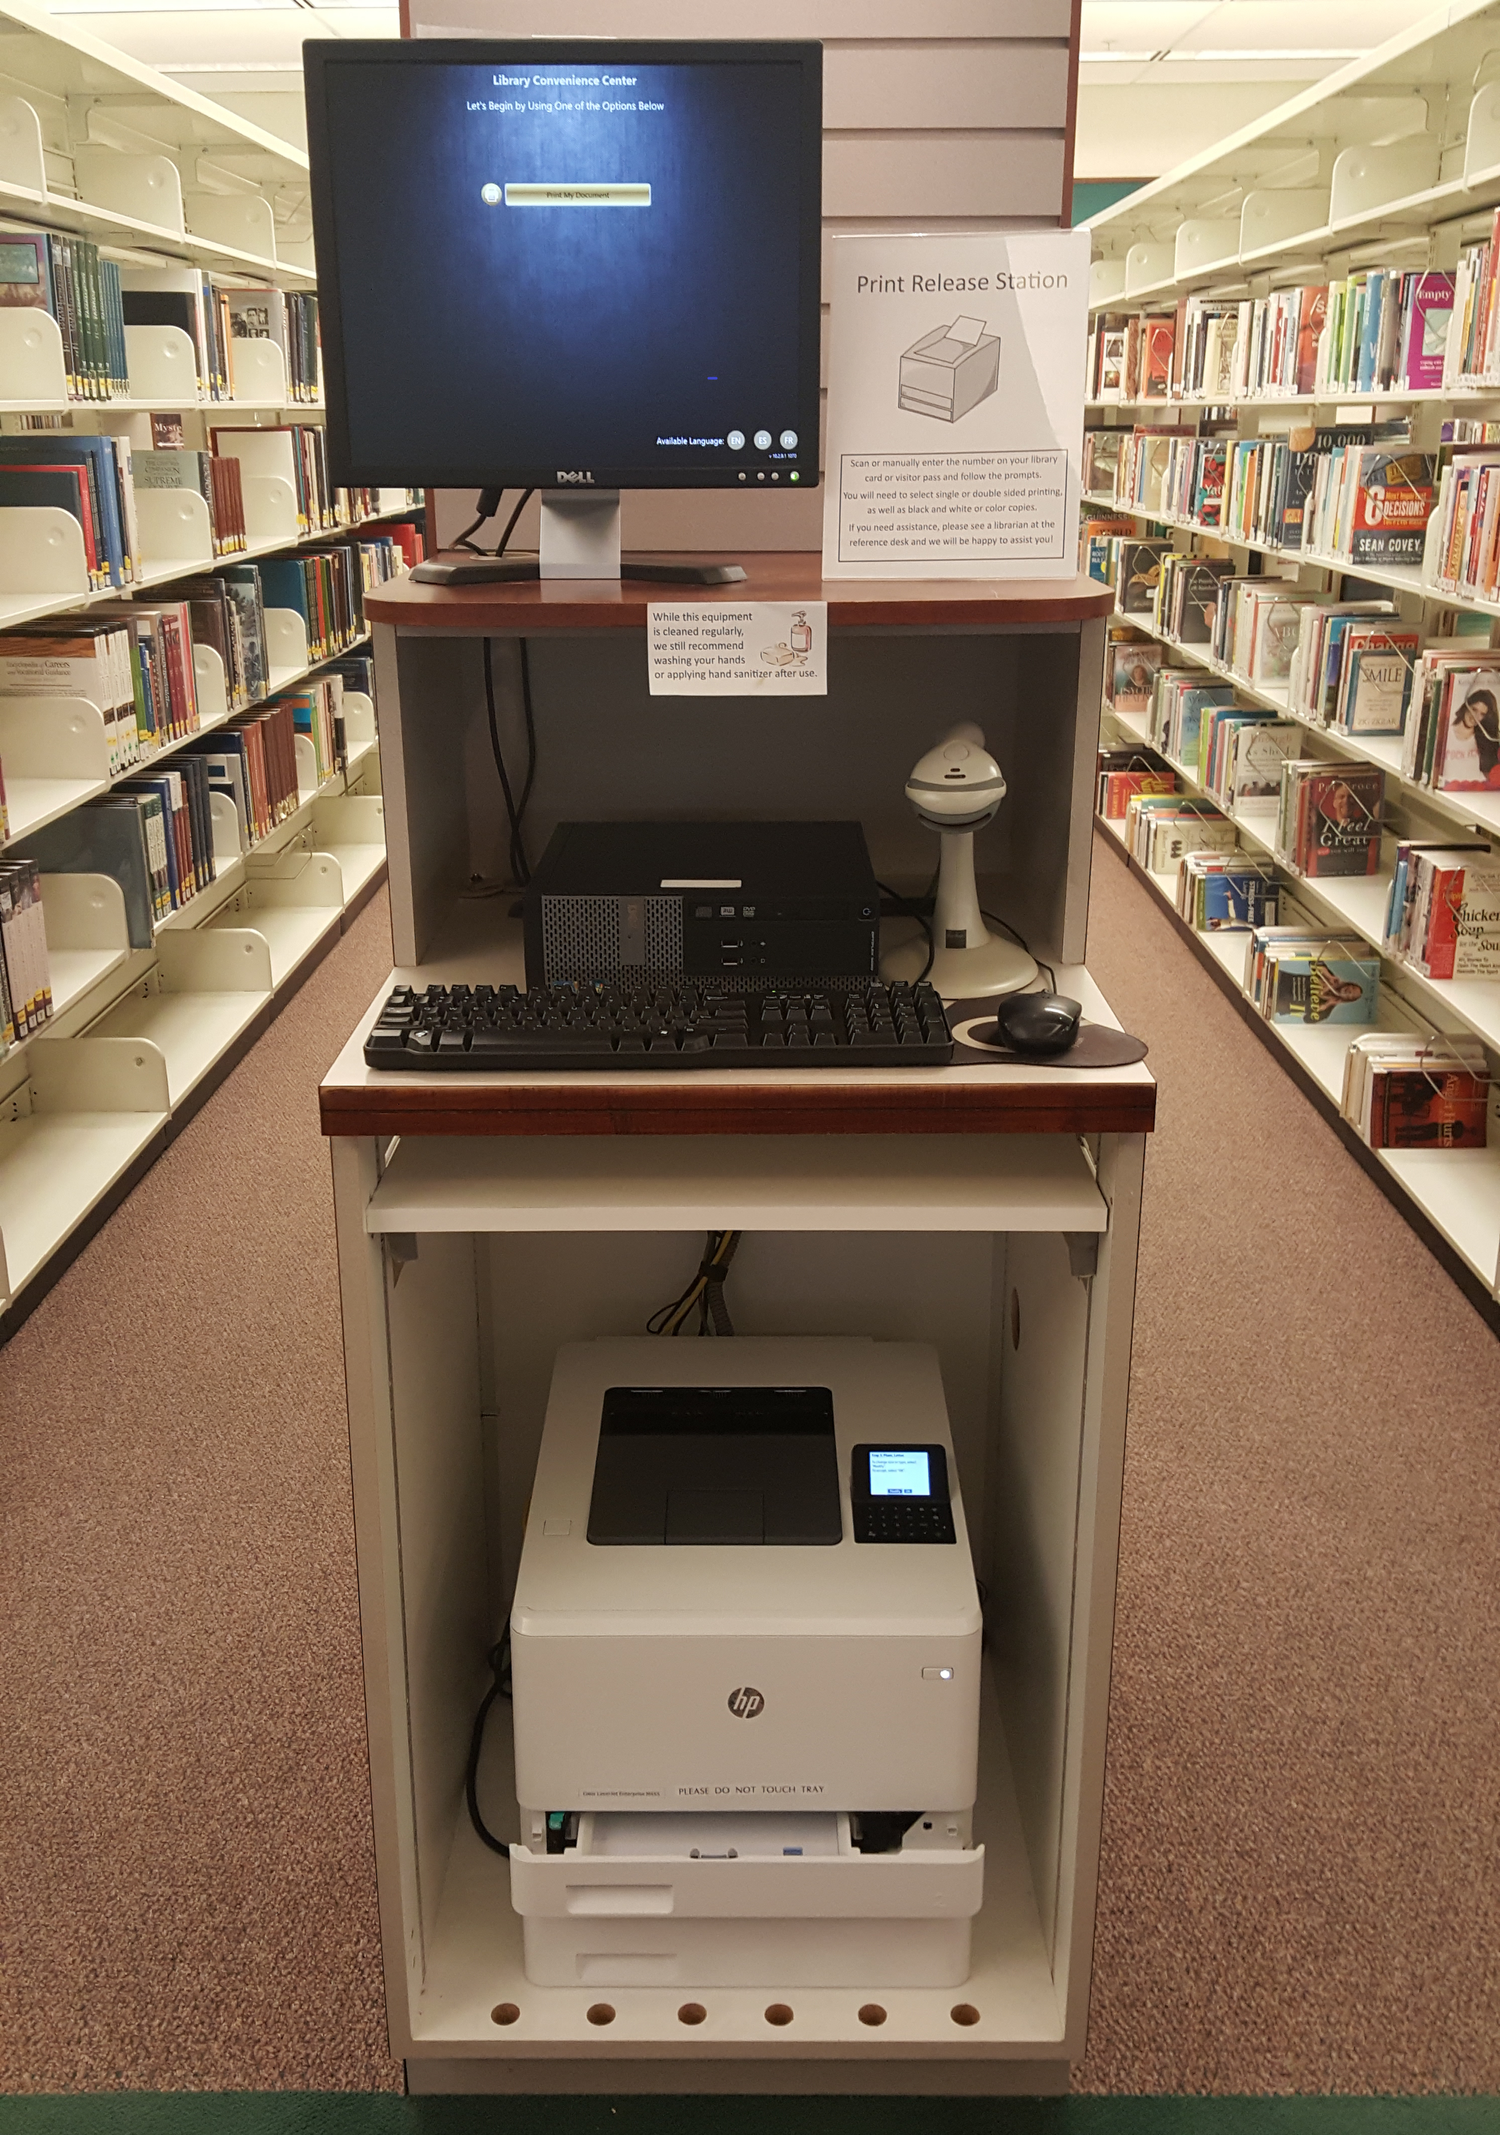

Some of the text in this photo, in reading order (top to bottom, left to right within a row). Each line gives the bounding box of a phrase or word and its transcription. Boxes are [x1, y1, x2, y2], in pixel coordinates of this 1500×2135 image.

[493, 74, 637, 88] Library Convenience Center
[467, 101, 664, 113] Let's Begin by Using One of the Options Below
[563, 192, 574, 200] My
[857, 271, 1068, 294] Print Release Station
[1418, 290, 1451, 301] Empty
[656, 437, 725, 447] Available Language:
[731, 436, 741, 445] EN
[758, 436, 767, 445] ES
[784, 436, 794, 445] FR
[850, 459, 870, 468] Scan
[883, 459, 920, 469] manually
[922, 459, 944, 467] enter
[946, 458, 960, 466] the
[962, 457, 994, 466] number
[1009, 457, 1029, 466] your
[1031, 455, 1058, 465] library
[557, 471, 595, 484] DELL
[865, 473, 883, 482] card
[895, 473, 921, 482] visitor
[923, 474, 941, 483] pass
[943, 472, 959, 481] and
[960, 471, 986, 481] follow
[988, 471, 1002, 480] the
[1004, 471, 1042, 481] prompts.
[843, 491, 858, 500] You
[860, 491, 874, 500] will
[876, 491, 897, 499] need
[899, 491, 908, 499] to
[910, 490, 934, 499] select
[936, 490, 960, 500] single
[972, 489, 1001, 498] double
[1004, 488, 1026, 497] sided
[1028, 488, 1063, 498] printing,
[878, 505, 895, 514] well
[908, 505, 929, 514] black
[931, 505, 947, 513] and
[949, 505, 972, 513] white
[985, 504, 1006, 512] color
[1008, 504, 1037, 514] copies.
[1364, 485, 1385, 526] 6
[1383, 500, 1425, 517] DECISIONS
[849, 524, 855, 532] If
[856, 525, 872, 533] you
[873, 523, 894, 532] need
[896, 522, 940, 532] assistance,
[942, 522, 968, 532] please
[994, 521, 1028, 530] librarian
[1030, 521, 1039, 529] at
[1041, 520, 1055, 529] the
[849, 538, 888, 547] reference
[890, 538, 909, 546] desk
[911, 537, 926, 545] and
[942, 537, 957, 545] will
[959, 537, 970, 545] be
[972, 536, 997, 546] happy
[1010, 536, 1033, 544] assist
[1034, 535, 1054, 545] you!
[1359, 538, 1420, 552] SEAN COVEY
[653, 612, 753, 623] While this equipment
[653, 626, 744, 637] is cleaned regularly,
[670, 641, 686, 650] still
[688, 641, 744, 650] recommend
[1353, 638, 1415, 650] Change
[45, 660, 70, 668] Careers
[654, 656, 745, 666] washing your hands
[654, 668, 818, 681] or applying hand sanitizer after use.
[1362, 667, 1402, 683] SMILE
[1347, 781, 1379, 791] roce
[1338, 817, 1370, 833] Feel
[1320, 833, 1368, 847] Great
[1247, 880, 1256, 923] STRESS-FREE
[1450, 924, 1484, 939] Soup
[1478, 939, 1500, 952] Sou
[1309, 963, 1324, 1021] Believe
[1290, 1003, 1306, 1017] It
[1443, 1112, 1456, 1147] Hurts
[730, 1687, 763, 1719] hp
[679, 1786, 824, 1796] PLEASE DO NOT TOUCH TRAY
